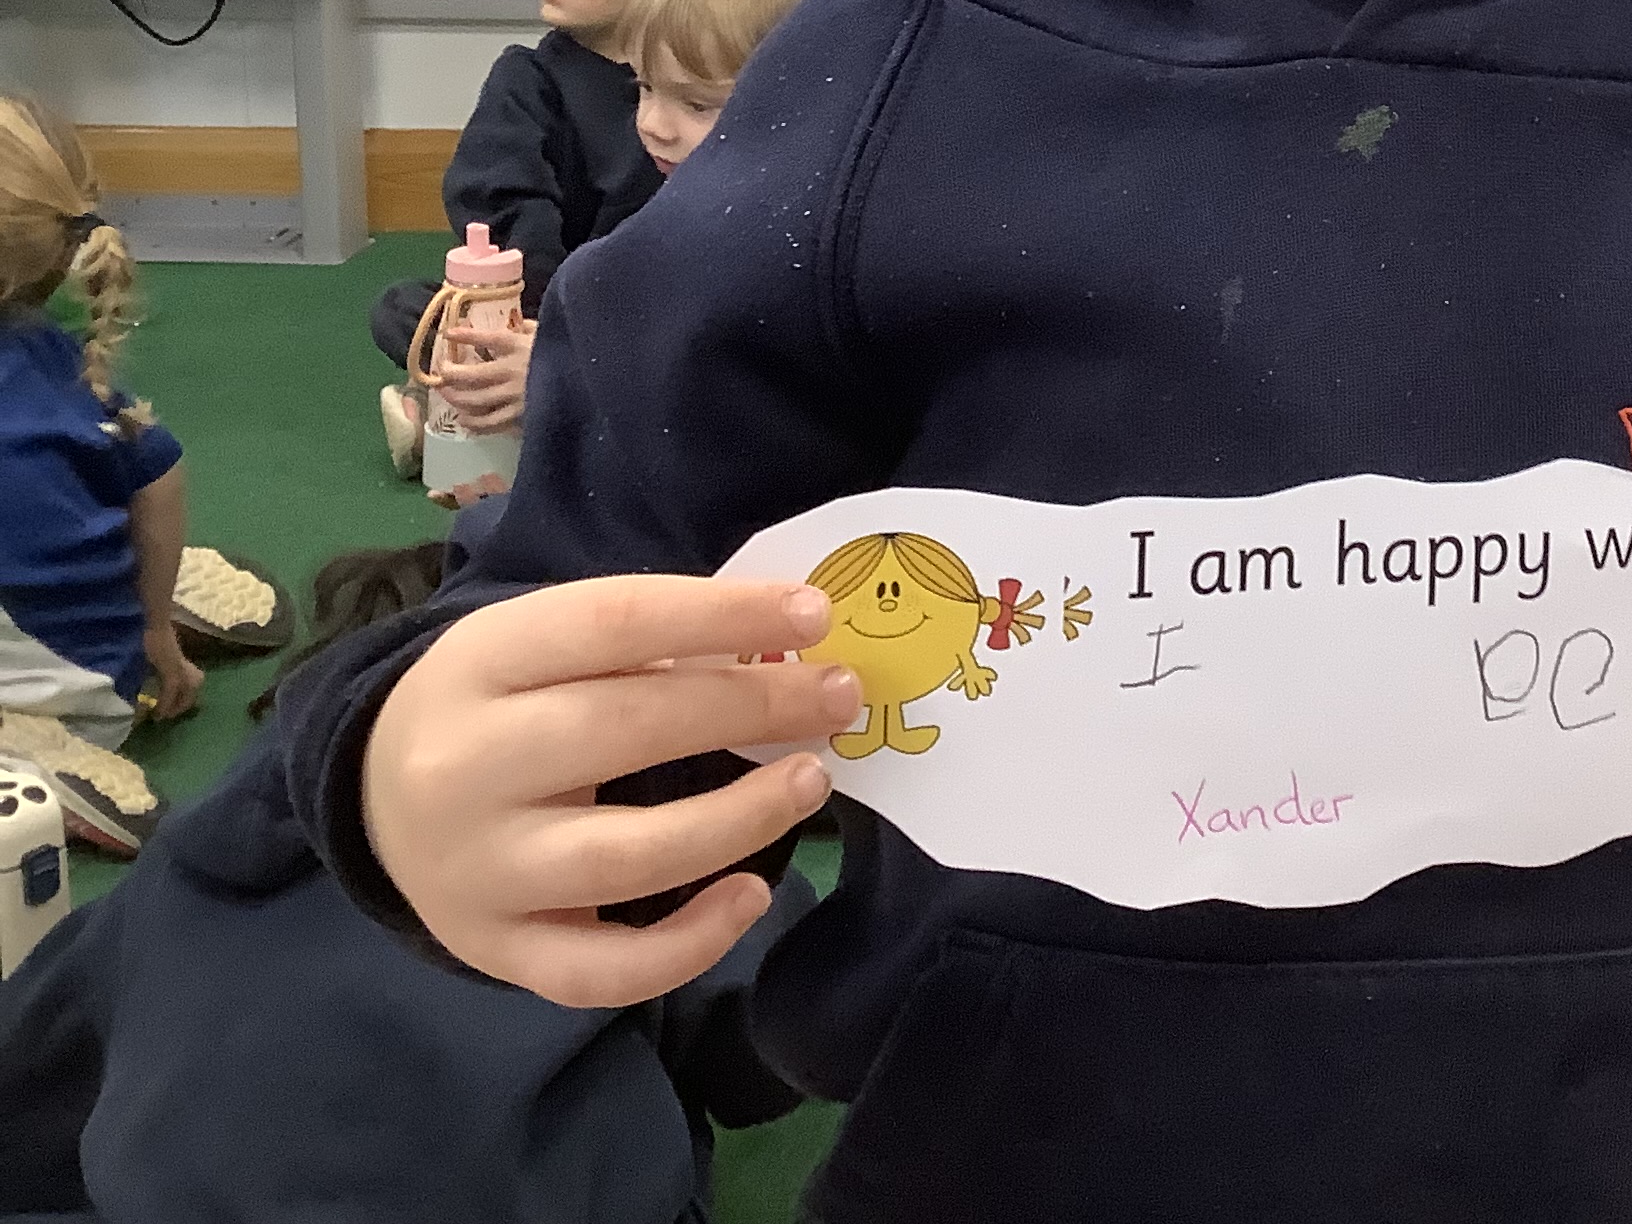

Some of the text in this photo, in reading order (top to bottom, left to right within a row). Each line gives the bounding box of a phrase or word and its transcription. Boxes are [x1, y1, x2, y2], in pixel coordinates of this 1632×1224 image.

[1127, 529, 1155, 599] I
[1189, 542, 1303, 596] am
[1337, 518, 1553, 607] happy
[1119, 620, 1201, 690] I
[1170, 770, 1356, 846] Xander
